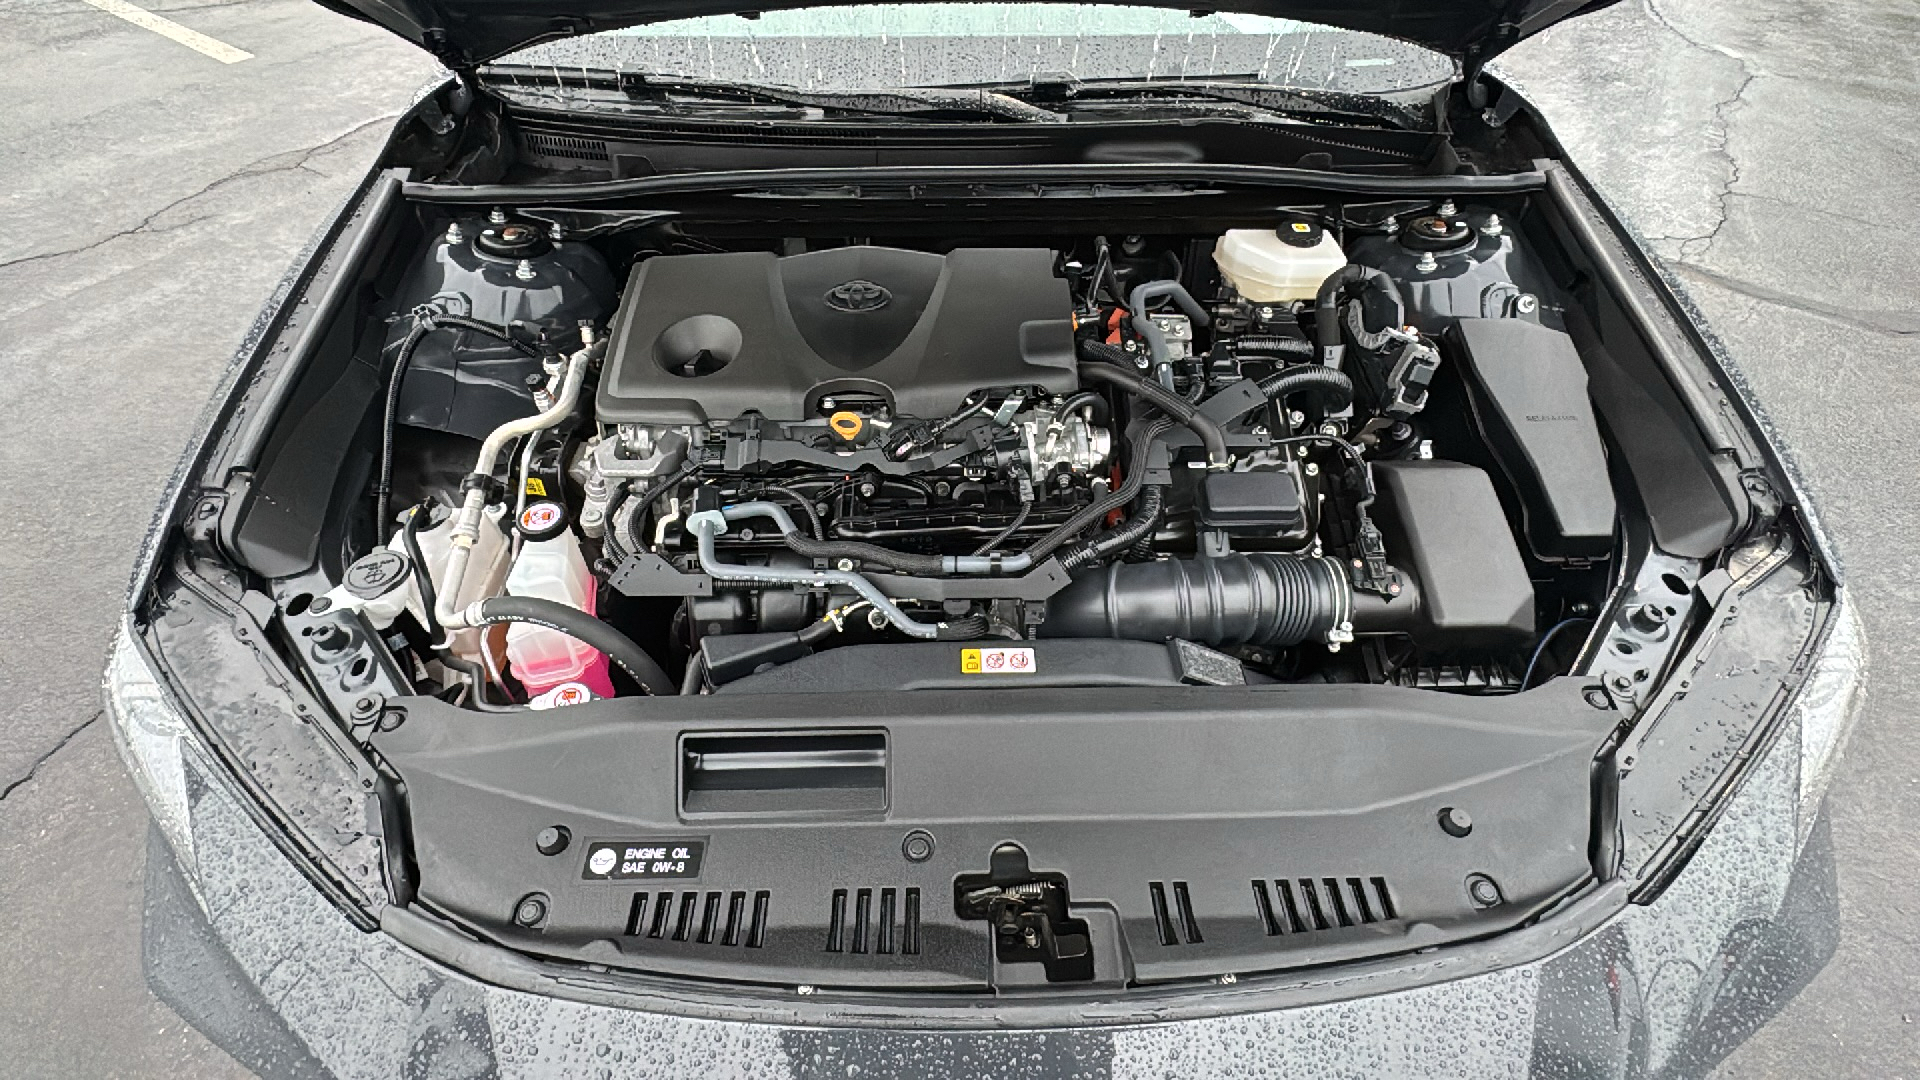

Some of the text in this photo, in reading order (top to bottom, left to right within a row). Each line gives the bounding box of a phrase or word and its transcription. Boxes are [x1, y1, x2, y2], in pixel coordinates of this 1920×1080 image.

[624, 847, 691, 860] ENGINE OIL
[621, 861, 647, 873] SAE
